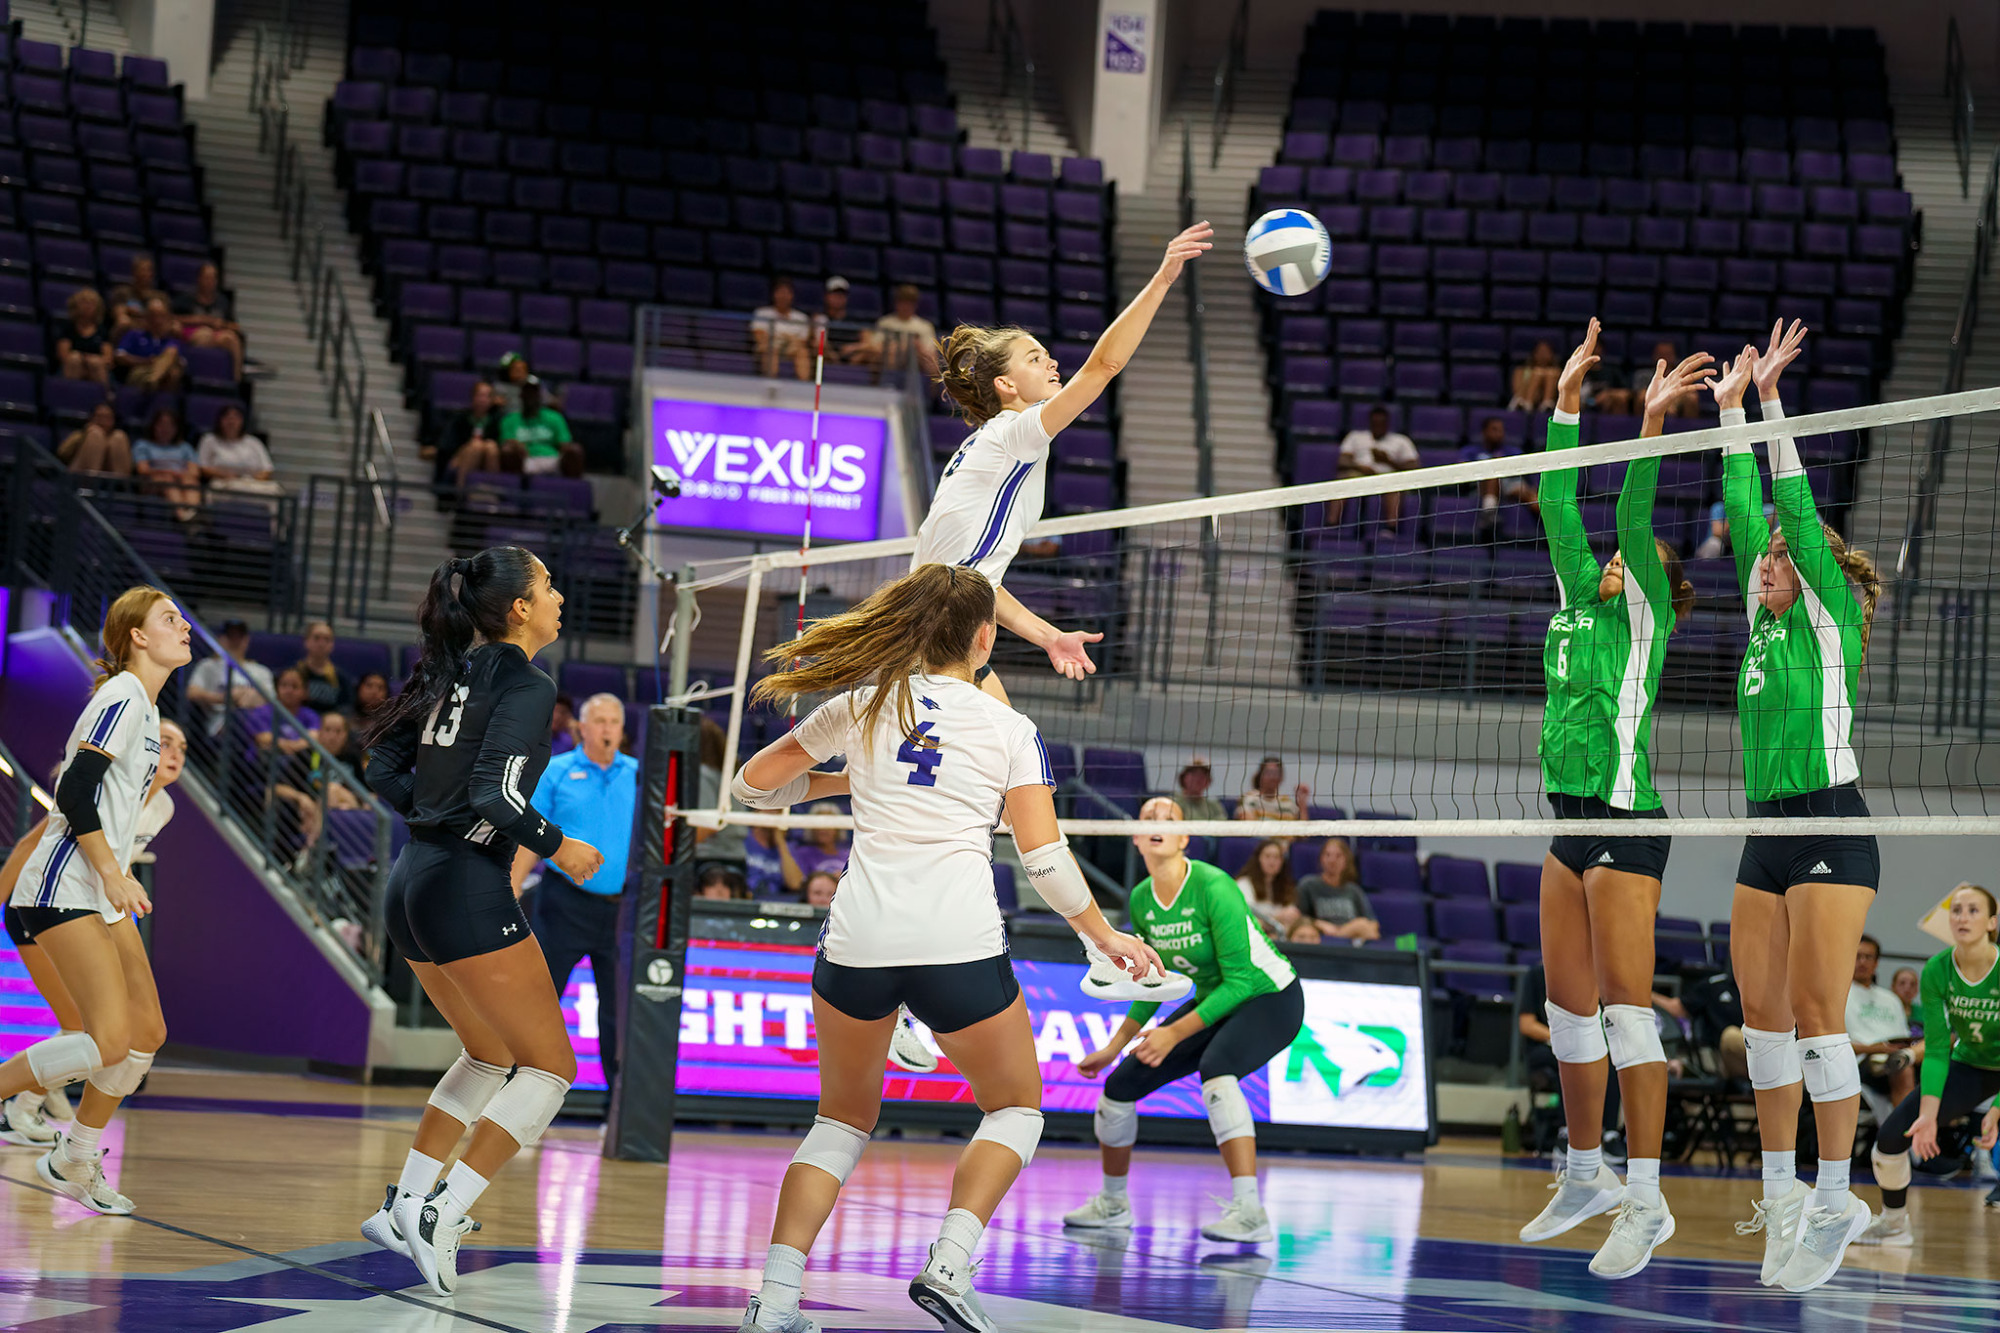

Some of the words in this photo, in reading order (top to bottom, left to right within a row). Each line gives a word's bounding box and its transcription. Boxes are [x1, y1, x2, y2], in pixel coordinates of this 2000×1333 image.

[664, 428, 867, 493] VEXUS
[421, 682, 470, 747] 13
[896, 720, 943, 787] 4
[1150, 920, 1193, 938] NORTH
[1172, 955, 1199, 975] 9
[1950, 994, 2000, 1010] NORTH
[1968, 1022, 1984, 1043] 3
